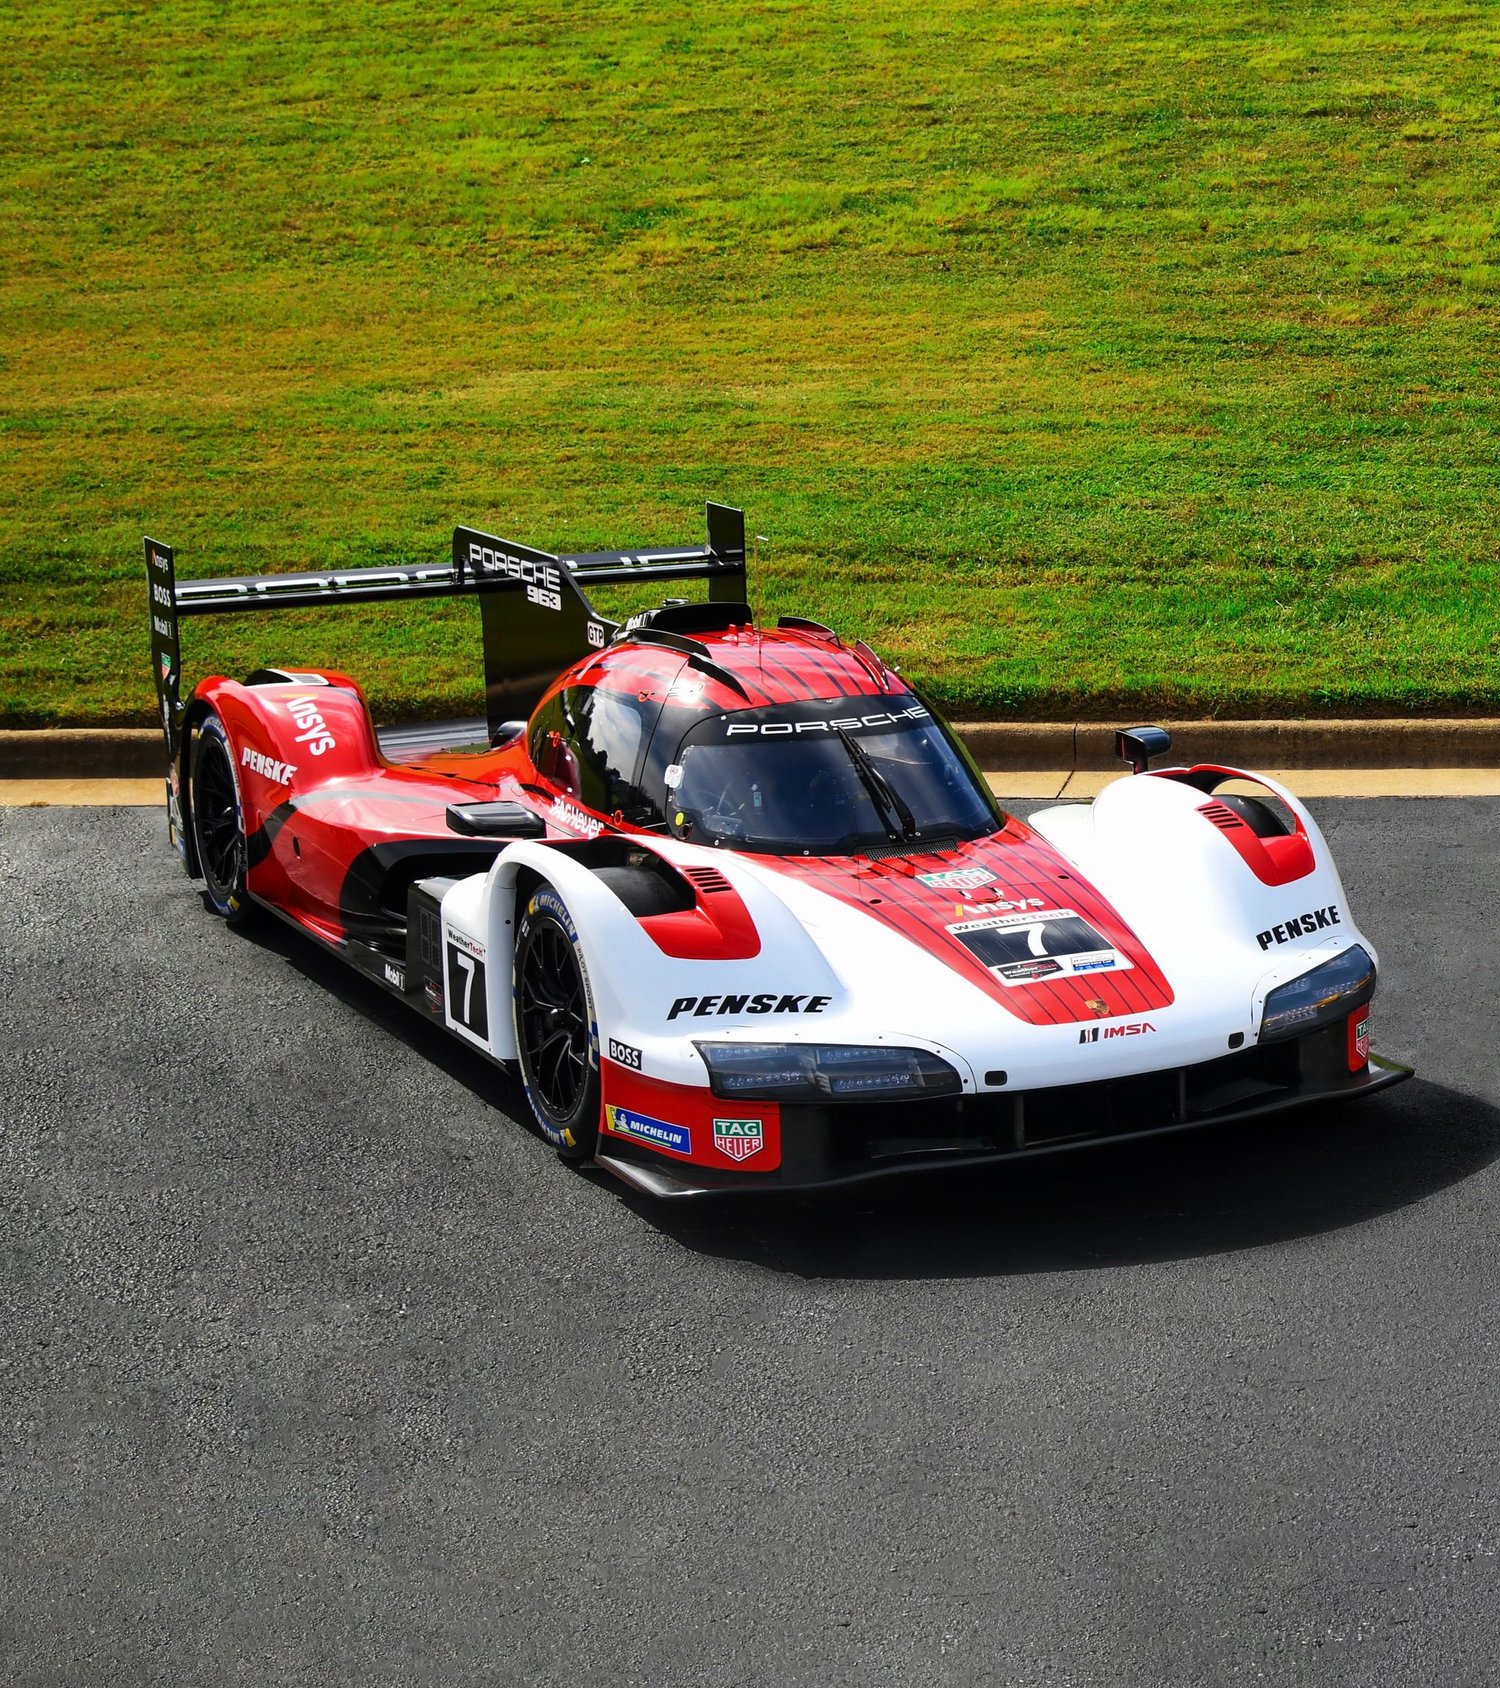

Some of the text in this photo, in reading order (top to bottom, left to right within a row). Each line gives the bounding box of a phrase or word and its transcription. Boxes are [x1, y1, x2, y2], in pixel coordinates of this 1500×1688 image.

[469, 543, 561, 592] PORSCHE
[153, 583, 172, 608] BOSS
[527, 584, 562, 611] 963
[588, 624, 604, 644] GTP
[281, 692, 337, 757] Ansys
[727, 706, 930, 736] PORSCHE
[241, 746, 298, 786] PENSKE
[540, 895, 577, 937] MICHELIN
[952, 910, 1071, 931] WeatherTech
[954, 898, 1045, 917] Ansys
[996, 923, 1050, 957] 7
[1256, 905, 1341, 951] PENSKE
[447, 928, 484, 957] WeatherTech
[456, 951, 475, 1025] 7
[667, 994, 832, 1021] PENSKE
[1103, 1022, 1157, 1039] IMSA
[610, 1040, 639, 1067] BOSS
[630, 1120, 682, 1144] MICHELIN
[716, 1121, 759, 1136] TAG
[716, 1137, 762, 1159] HEUER
